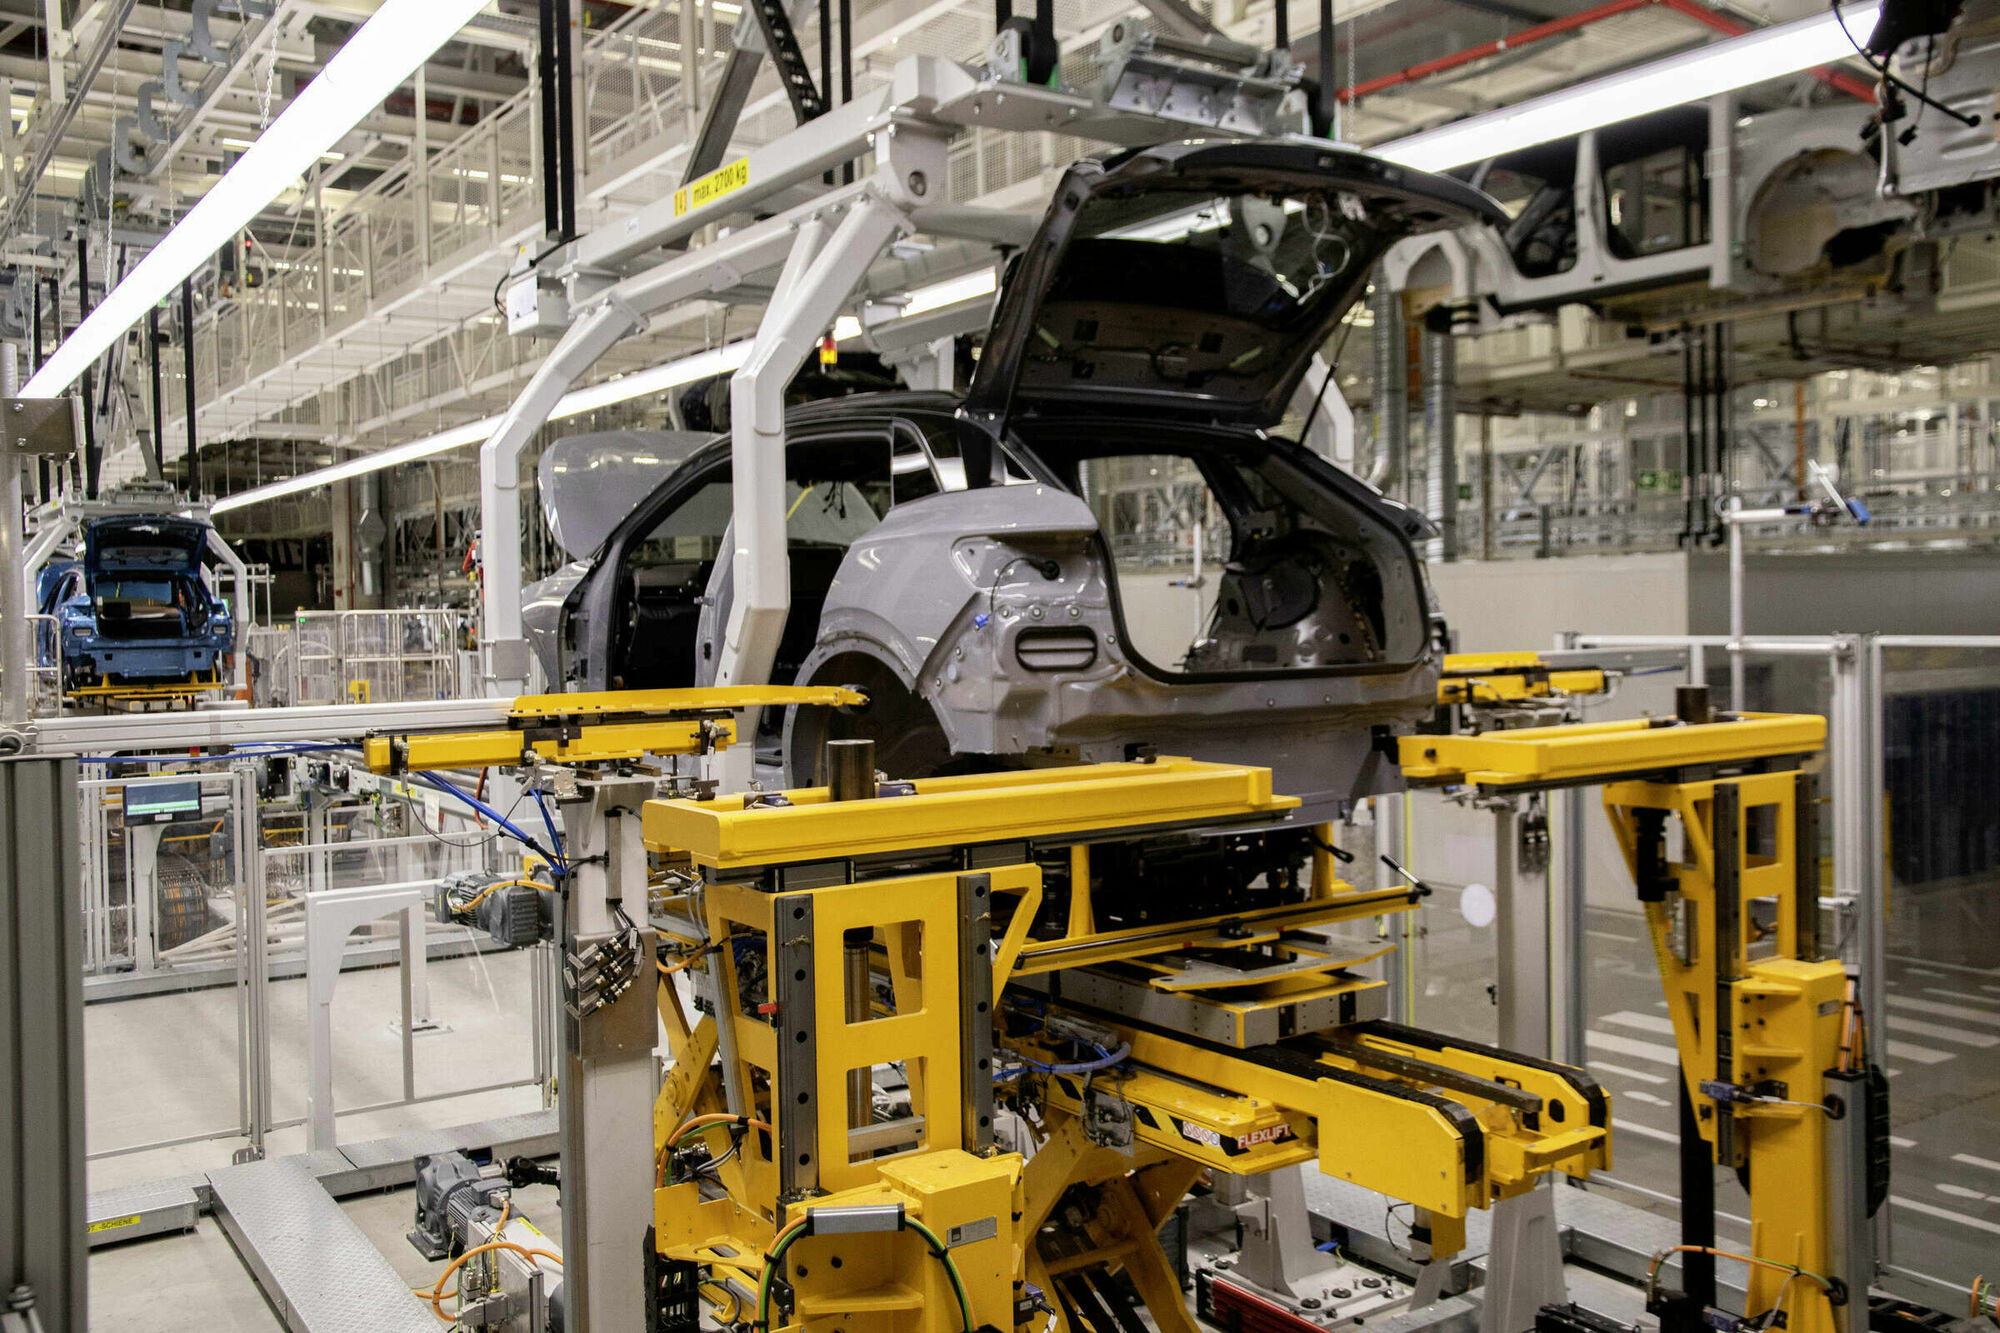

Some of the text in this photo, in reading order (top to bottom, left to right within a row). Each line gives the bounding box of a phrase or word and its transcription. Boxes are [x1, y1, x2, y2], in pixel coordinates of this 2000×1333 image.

[714, 167, 734, 192] 2700
[736, 163, 747, 185] kg
[1237, 1124, 1290, 1149] FLEXLIFT
